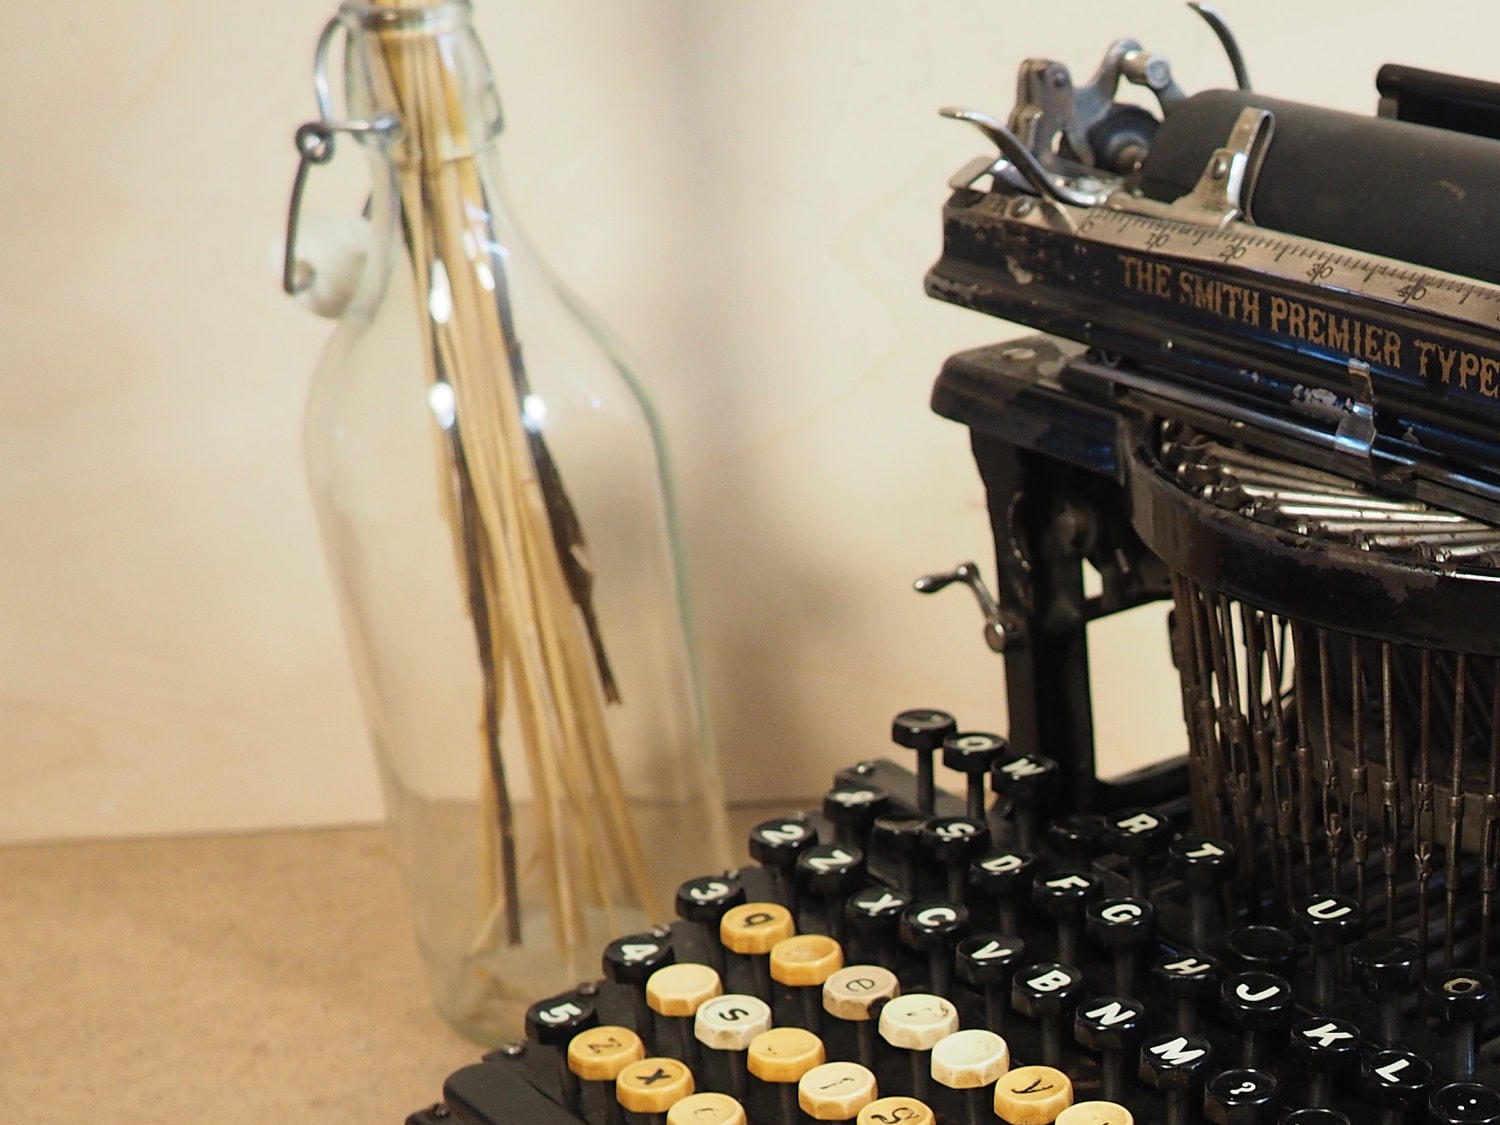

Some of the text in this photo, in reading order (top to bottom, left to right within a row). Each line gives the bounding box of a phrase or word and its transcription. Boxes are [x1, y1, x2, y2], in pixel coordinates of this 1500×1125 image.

[1117, 253, 1172, 299] THE
[1178, 270, 1261, 328] SMITH
[1270, 295, 1401, 369] PREMIER
[1026, 969, 1071, 992] B
[1236, 983, 1280, 1001] J
[1302, 1023, 1354, 1047] K
[1150, 1036, 1205, 1065] M
